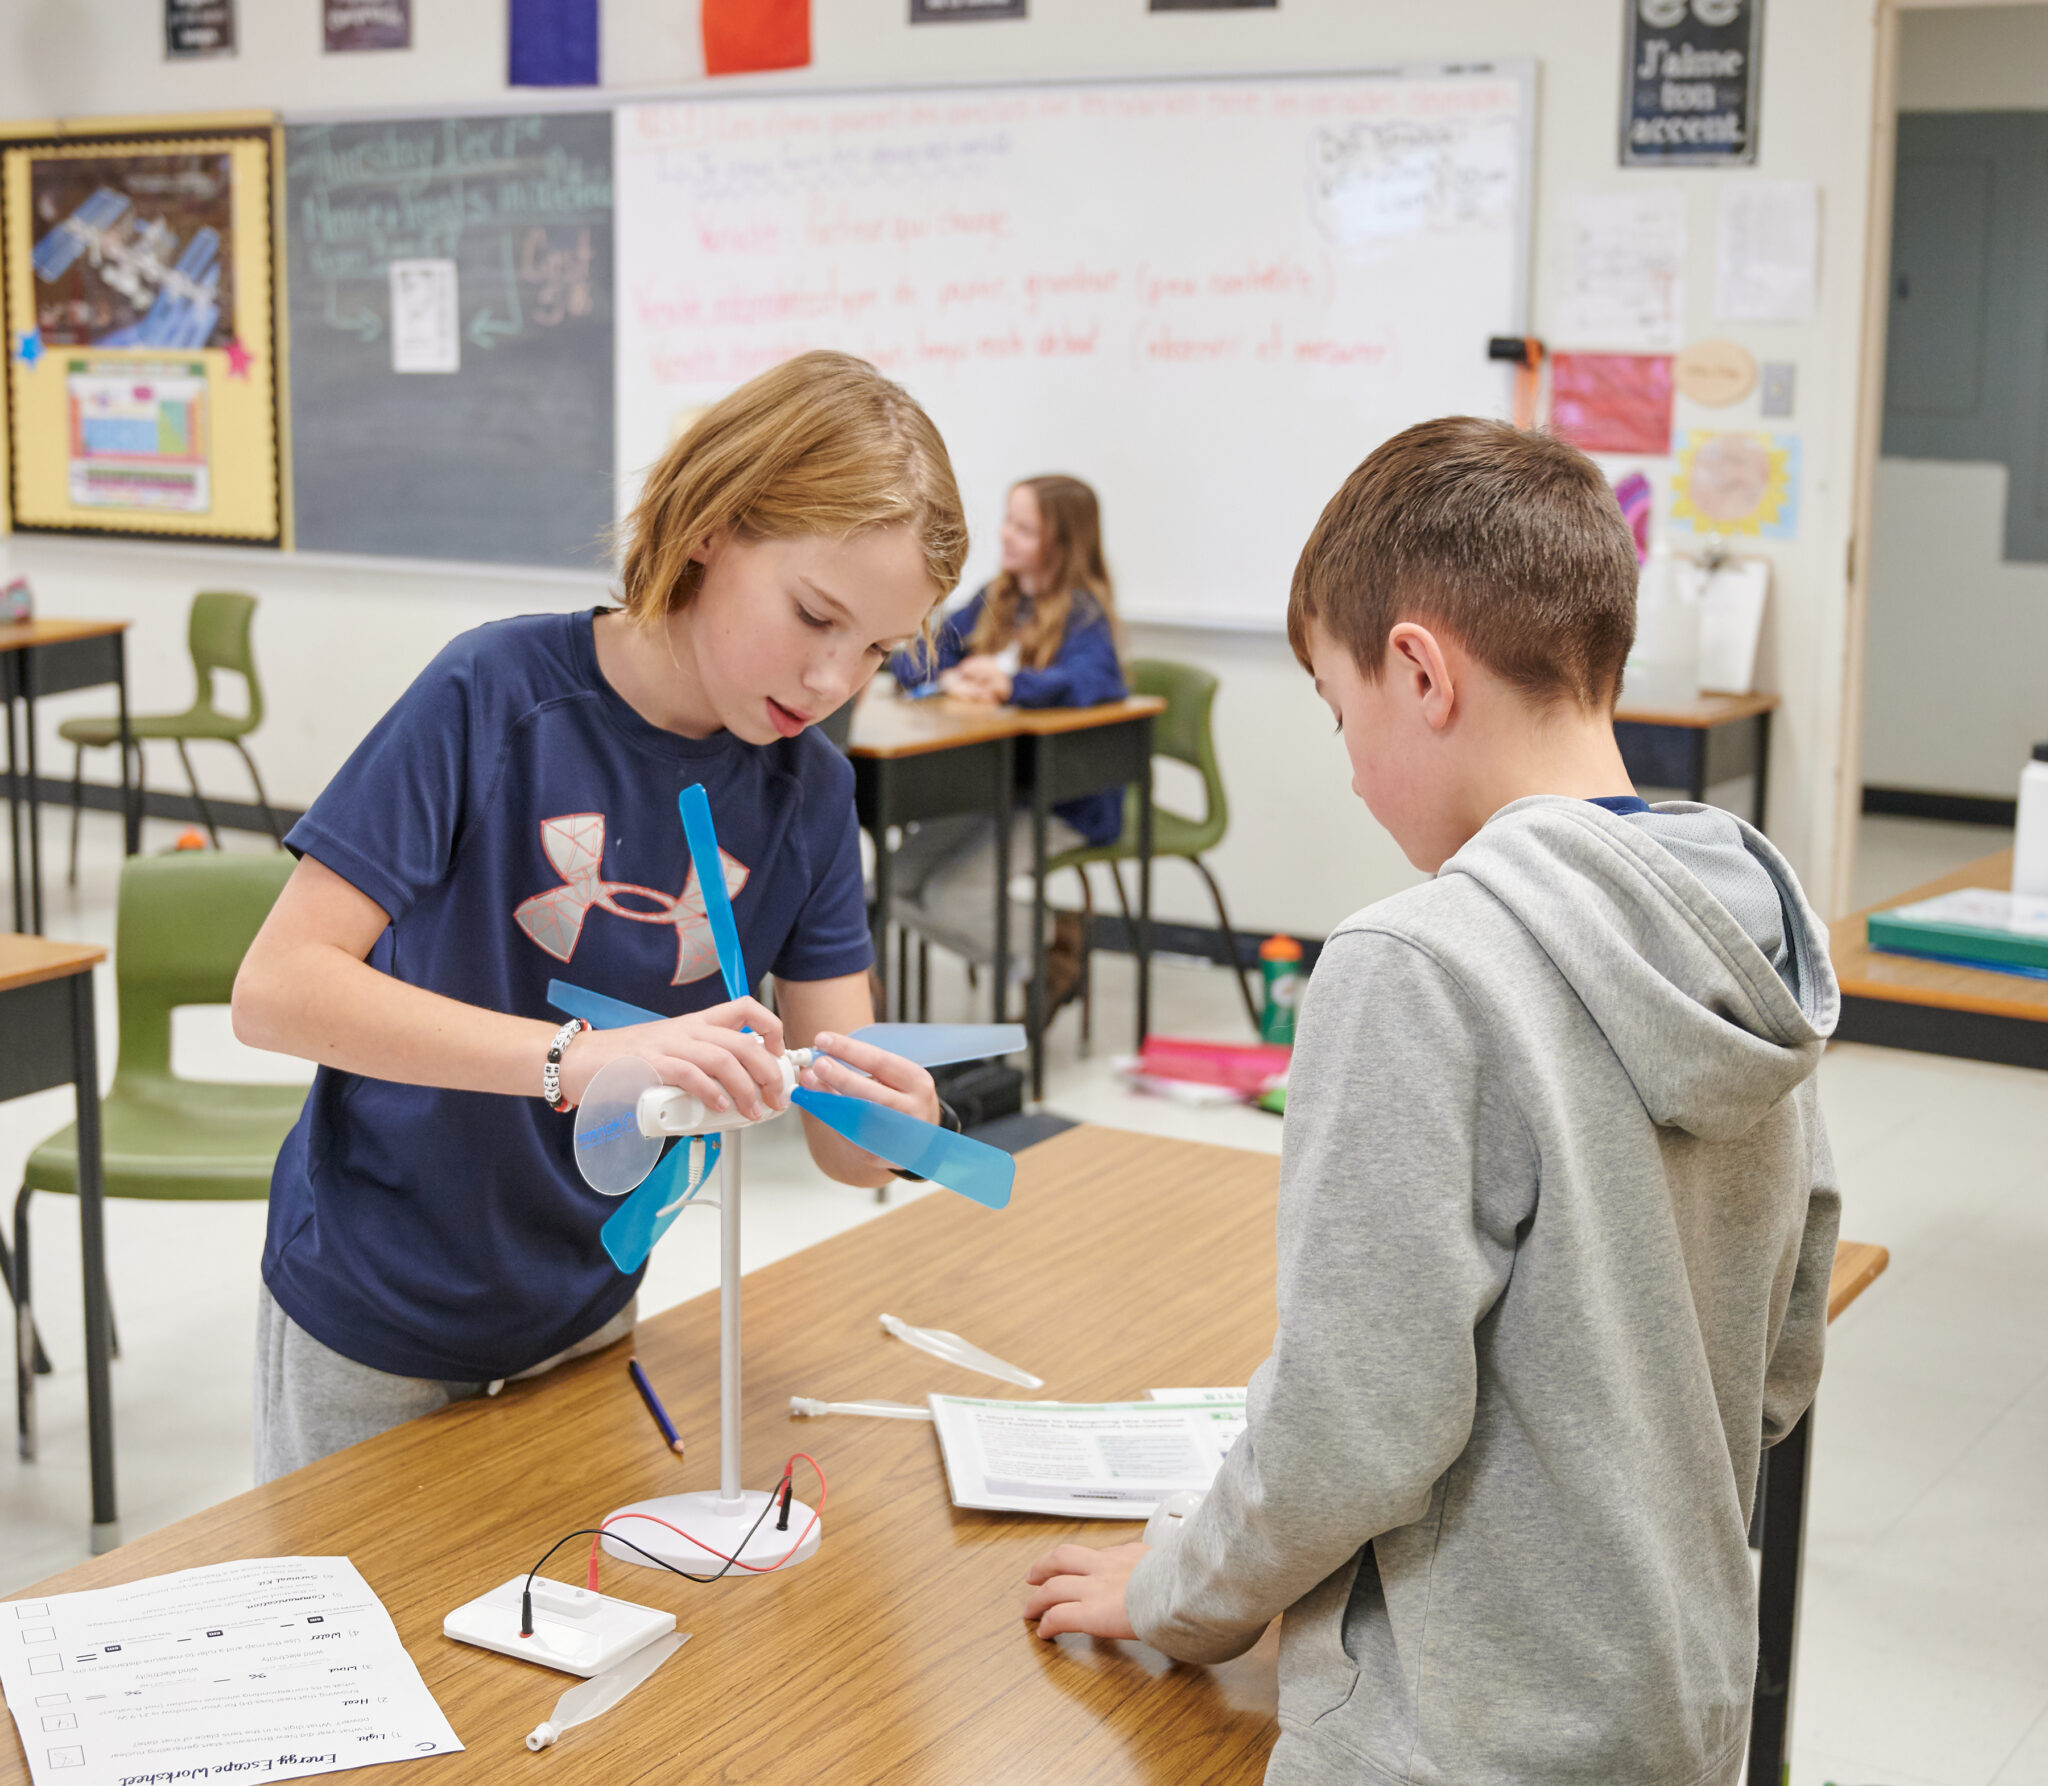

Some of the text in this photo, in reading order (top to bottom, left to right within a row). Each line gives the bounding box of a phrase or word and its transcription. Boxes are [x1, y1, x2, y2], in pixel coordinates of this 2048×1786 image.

[1661, 82, 1716, 110] ton
[245, 1594, 325, 1609] Communication
[310, 1632, 341, 1641] Water
[261, 1653, 301, 1662] electricity
[328, 1665, 357, 1674] Wind
[135, 1671, 176, 1680] electricity
[342, 1698, 368, 1706] Heat
[357, 1734, 385, 1742] Light
[118, 1754, 336, 1786] Energy Escape Worksheet
